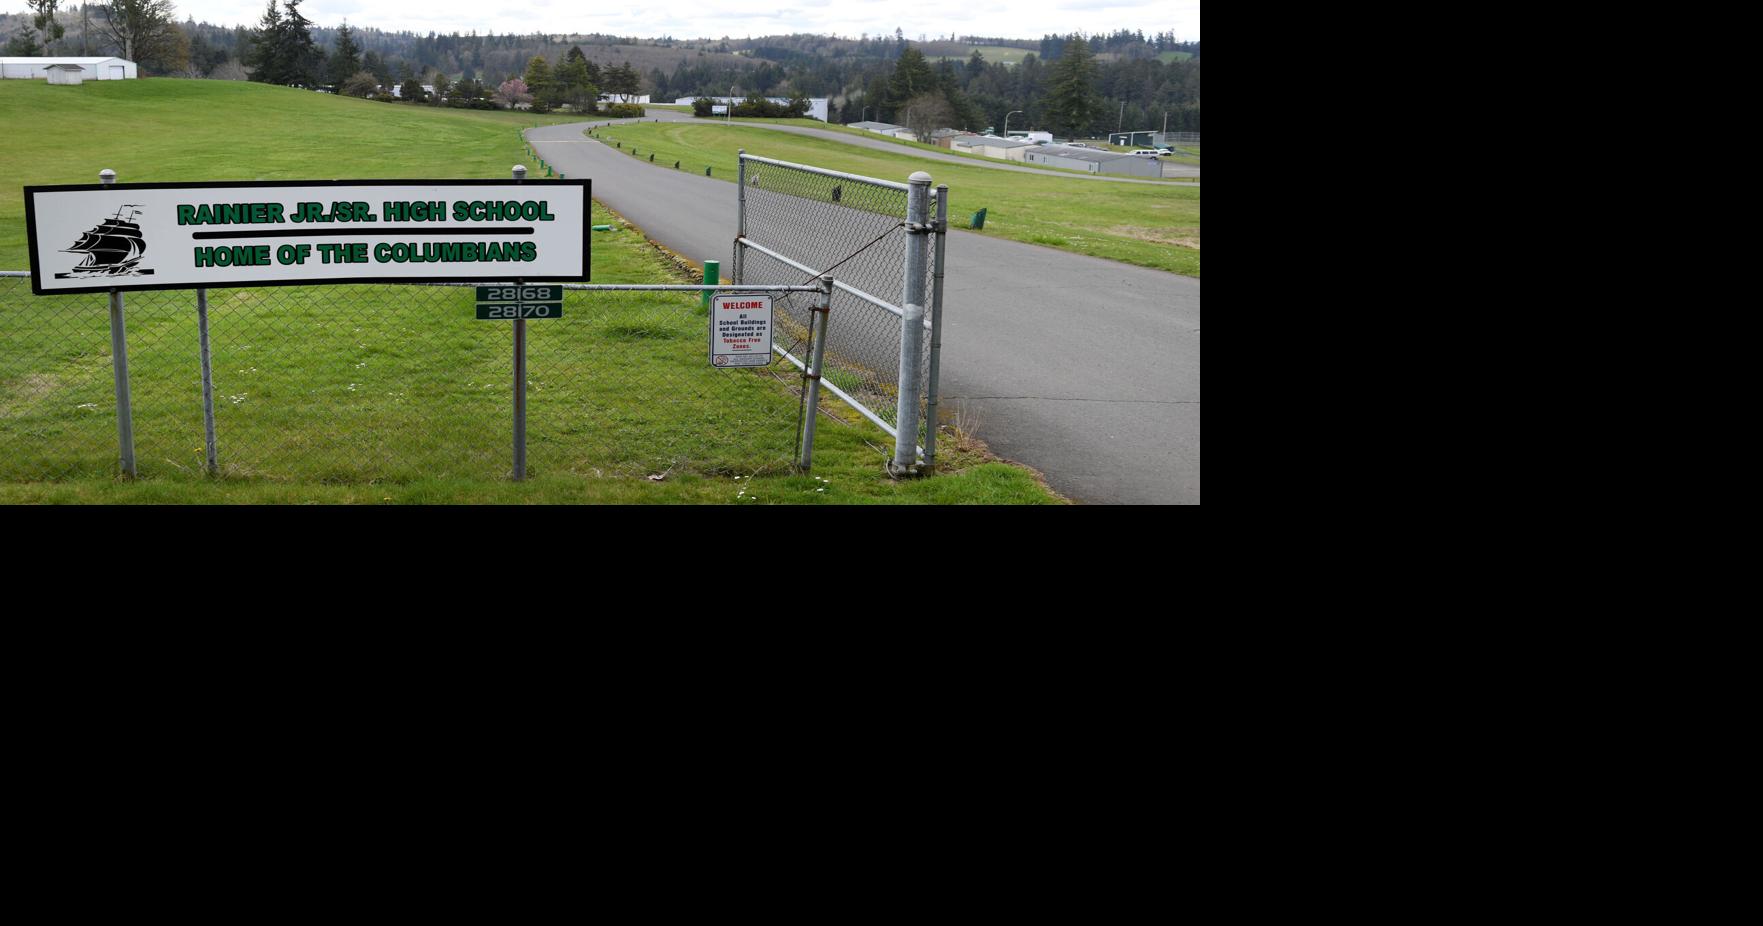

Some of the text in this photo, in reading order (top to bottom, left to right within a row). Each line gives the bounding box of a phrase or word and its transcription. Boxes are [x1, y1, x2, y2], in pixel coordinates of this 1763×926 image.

[177, 201, 555, 225] RAINIER JR./SR. HIGH SCHOOL
[194, 242, 537, 267] HOME OF THE COLUMBIANS
[722, 301, 763, 310] WELCOME
